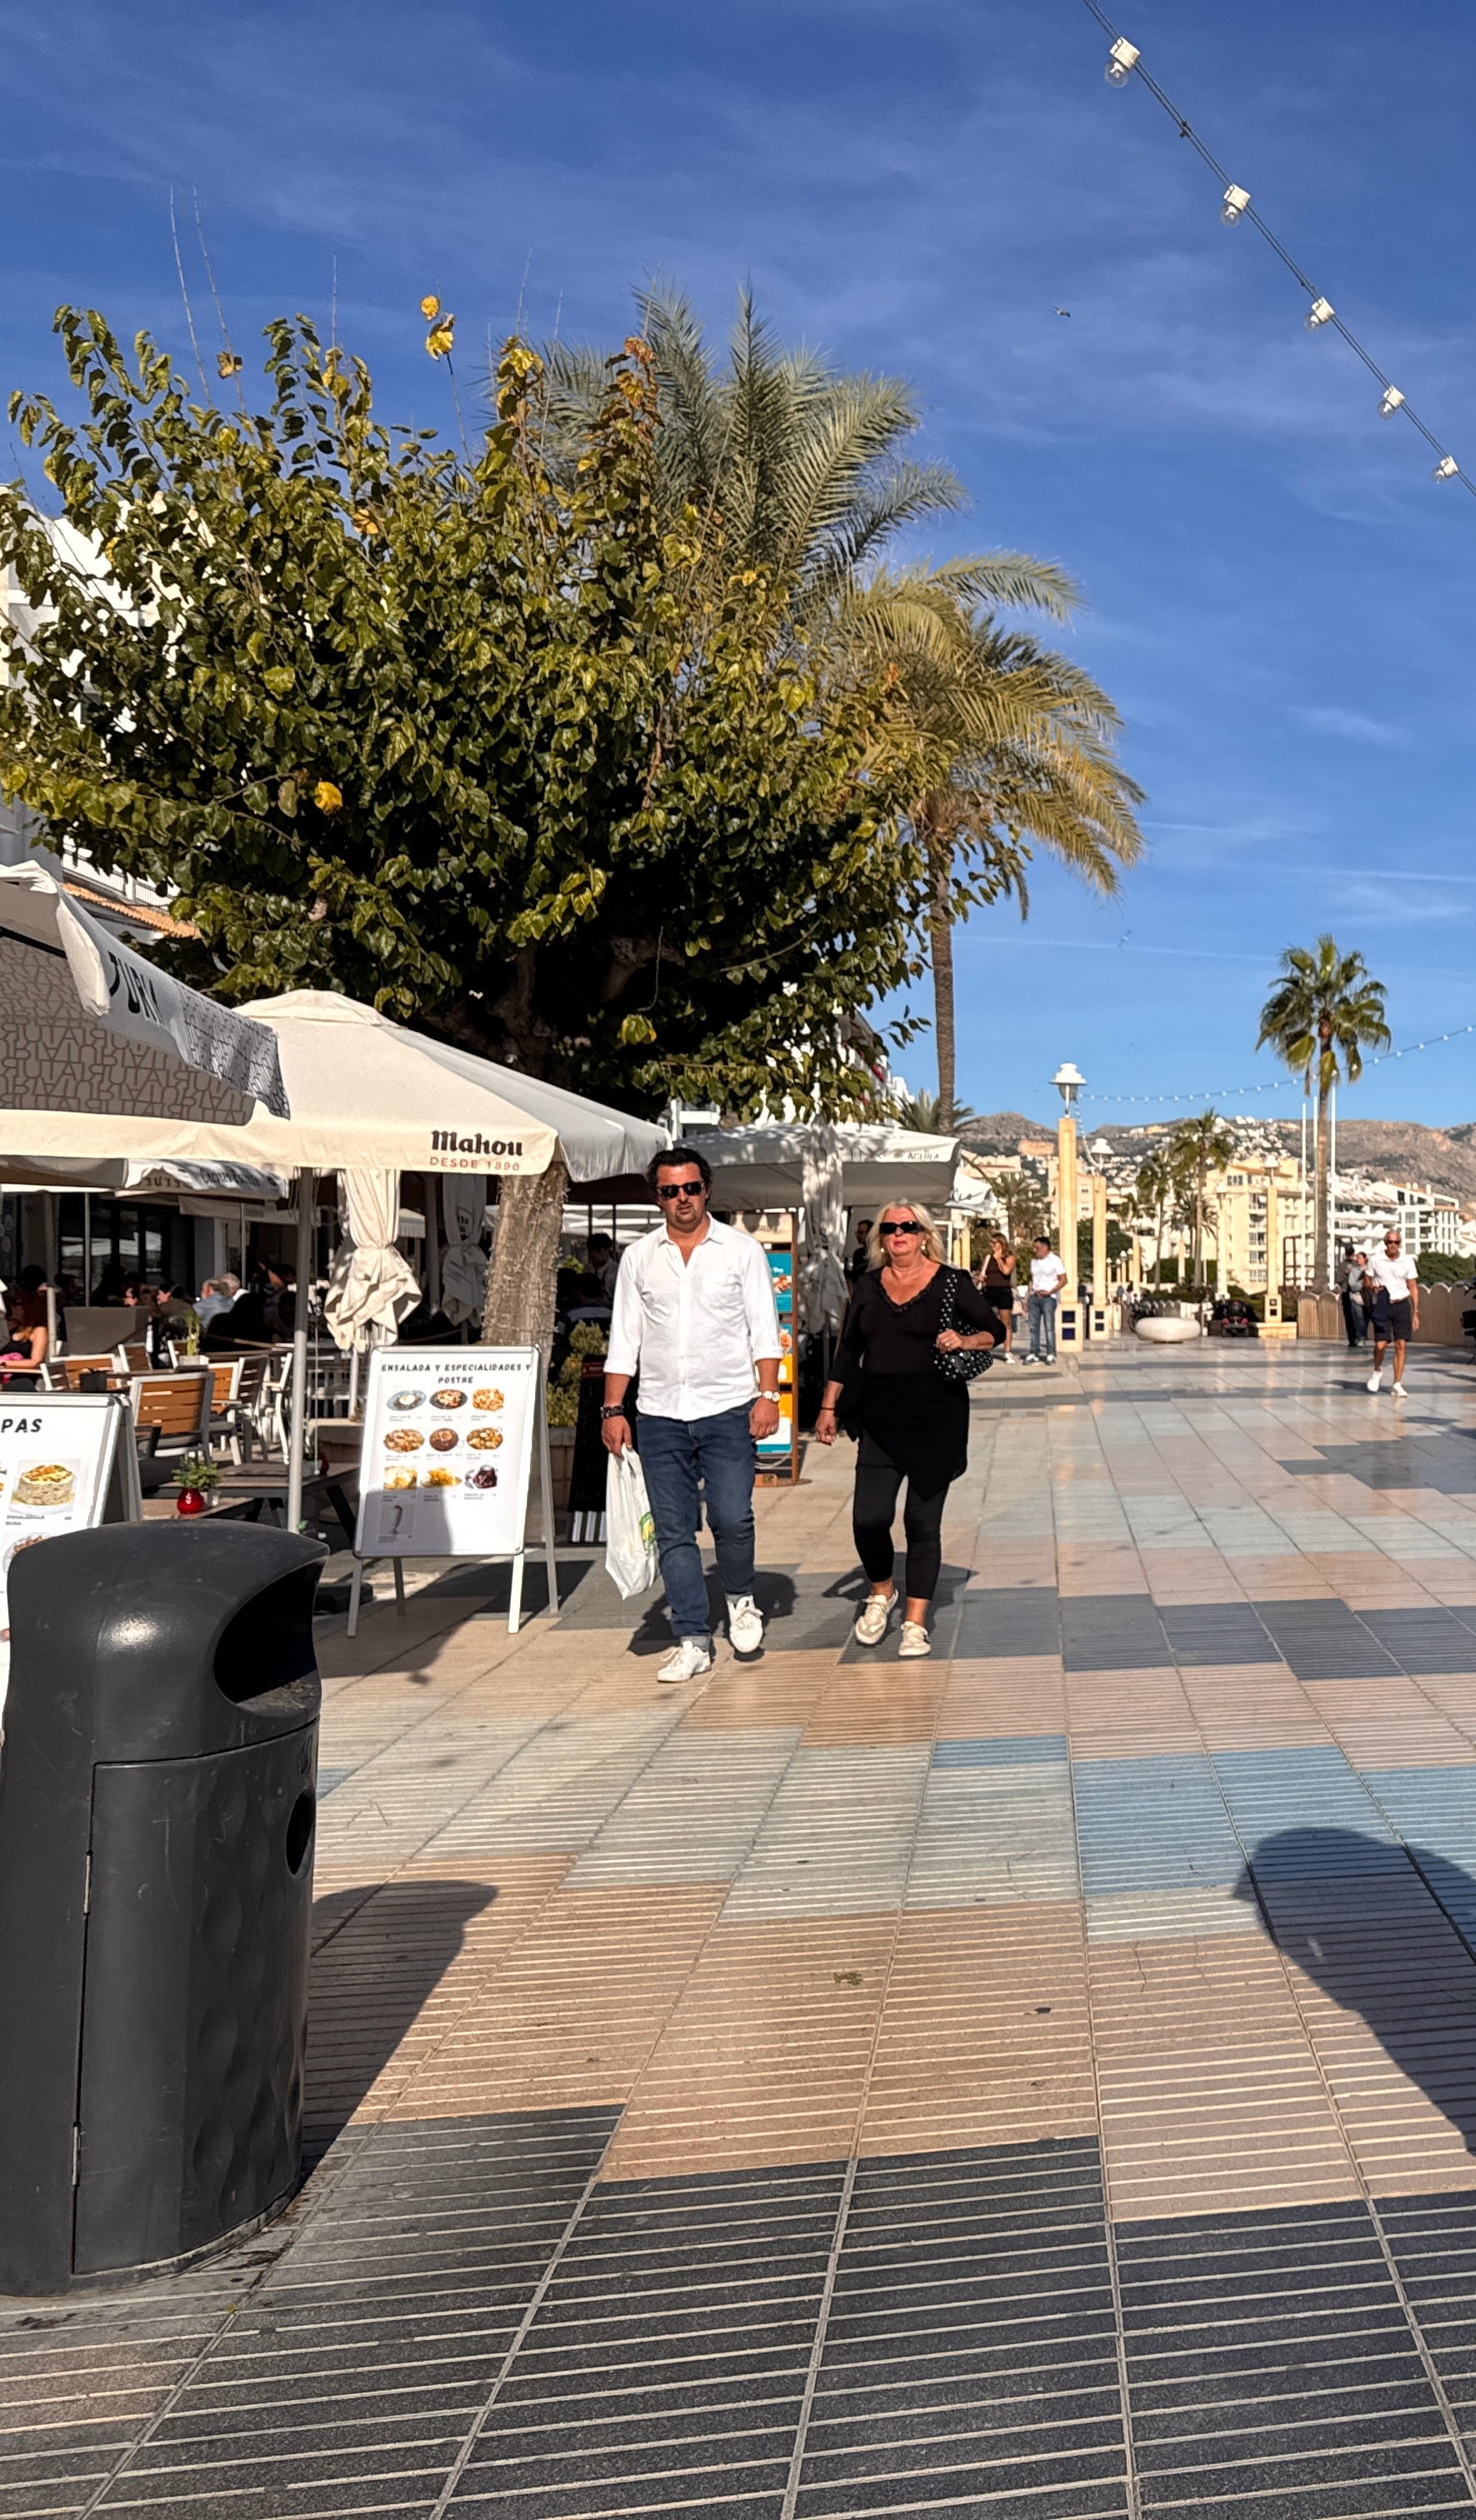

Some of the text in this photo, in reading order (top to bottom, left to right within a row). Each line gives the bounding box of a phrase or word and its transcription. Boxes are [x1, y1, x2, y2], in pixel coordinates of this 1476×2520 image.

[430, 1129, 523, 1157] Mahou
[429, 1156, 520, 1172] DESDE 1890
[381, 1363, 431, 1372] ENSALADA
[444, 1363, 522, 1372] ESPECIALIDADES
[438, 1376, 474, 1384] POSTRE
[1, 1418, 43, 1433] PAS
